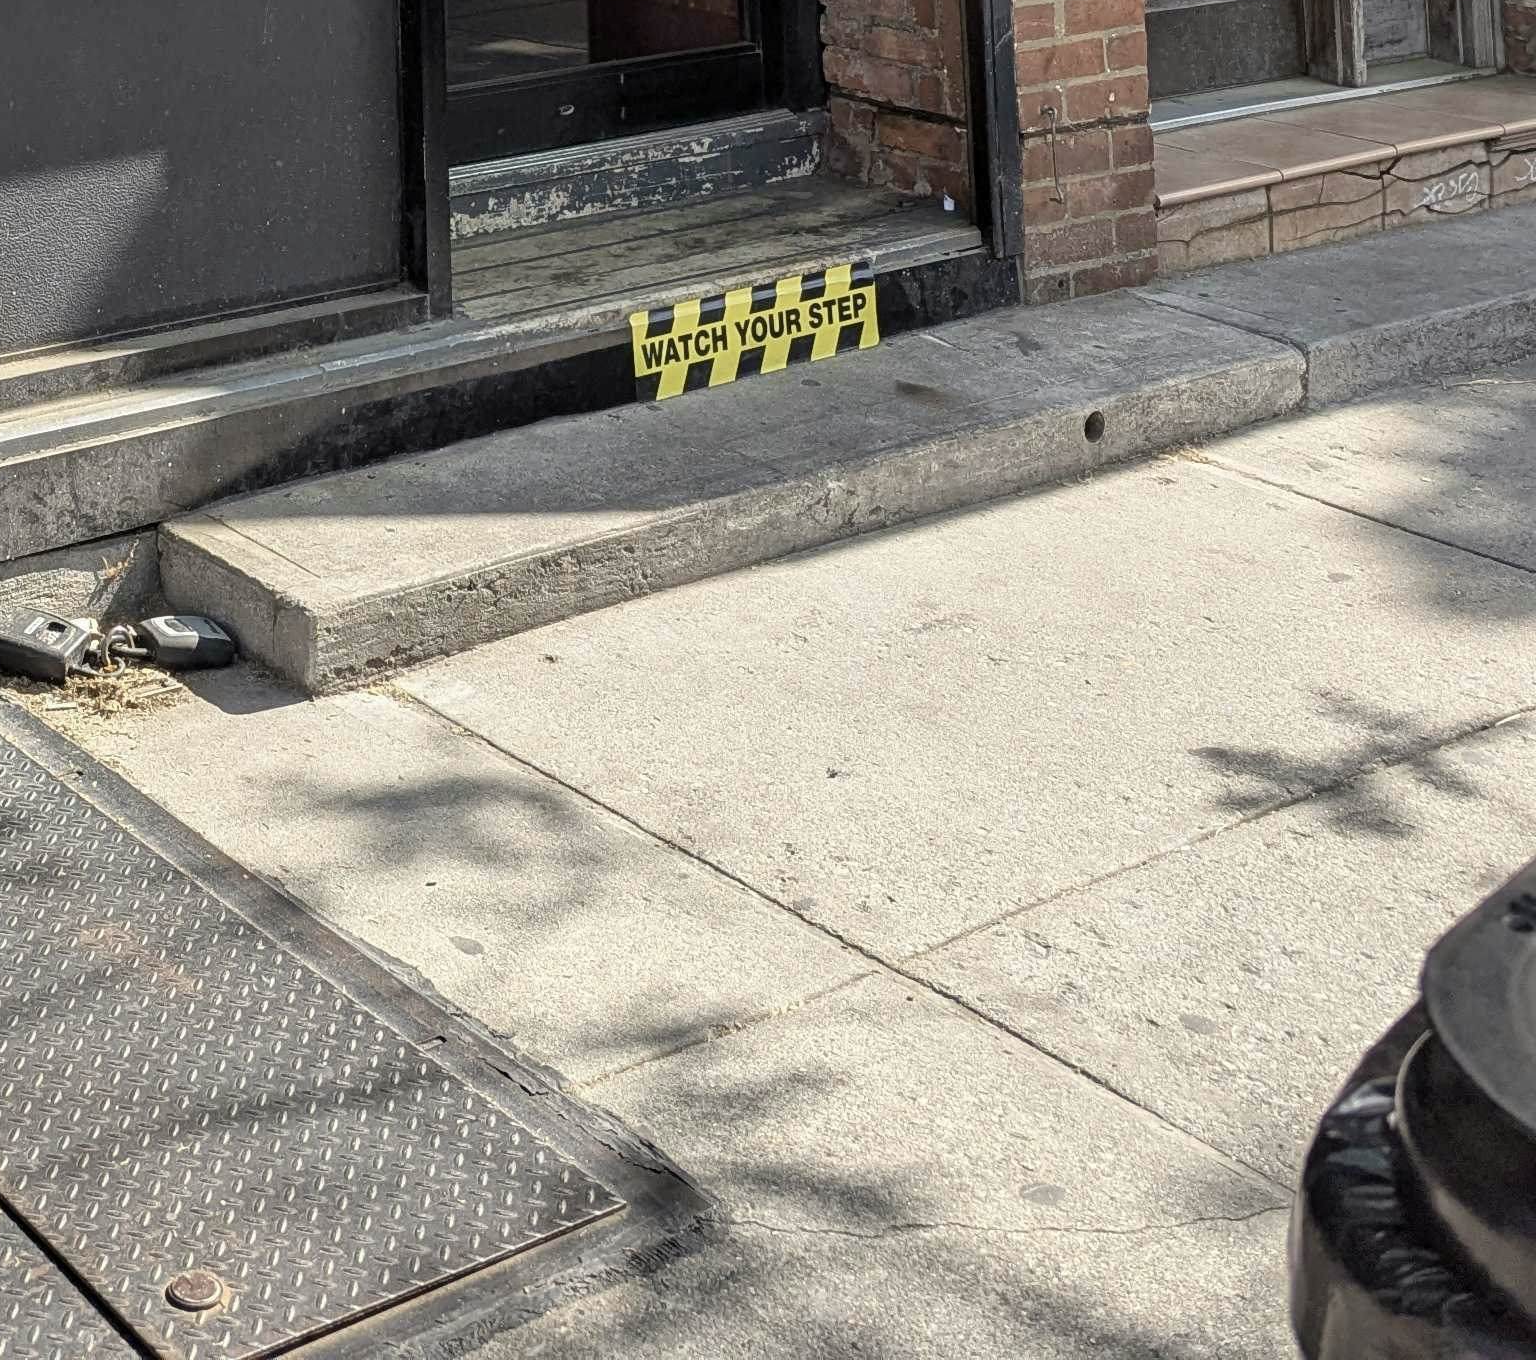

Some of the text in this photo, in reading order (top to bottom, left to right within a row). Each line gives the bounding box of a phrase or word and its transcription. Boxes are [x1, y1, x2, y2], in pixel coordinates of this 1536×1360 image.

[640, 292, 867, 370] WATCH YOUR STEP
